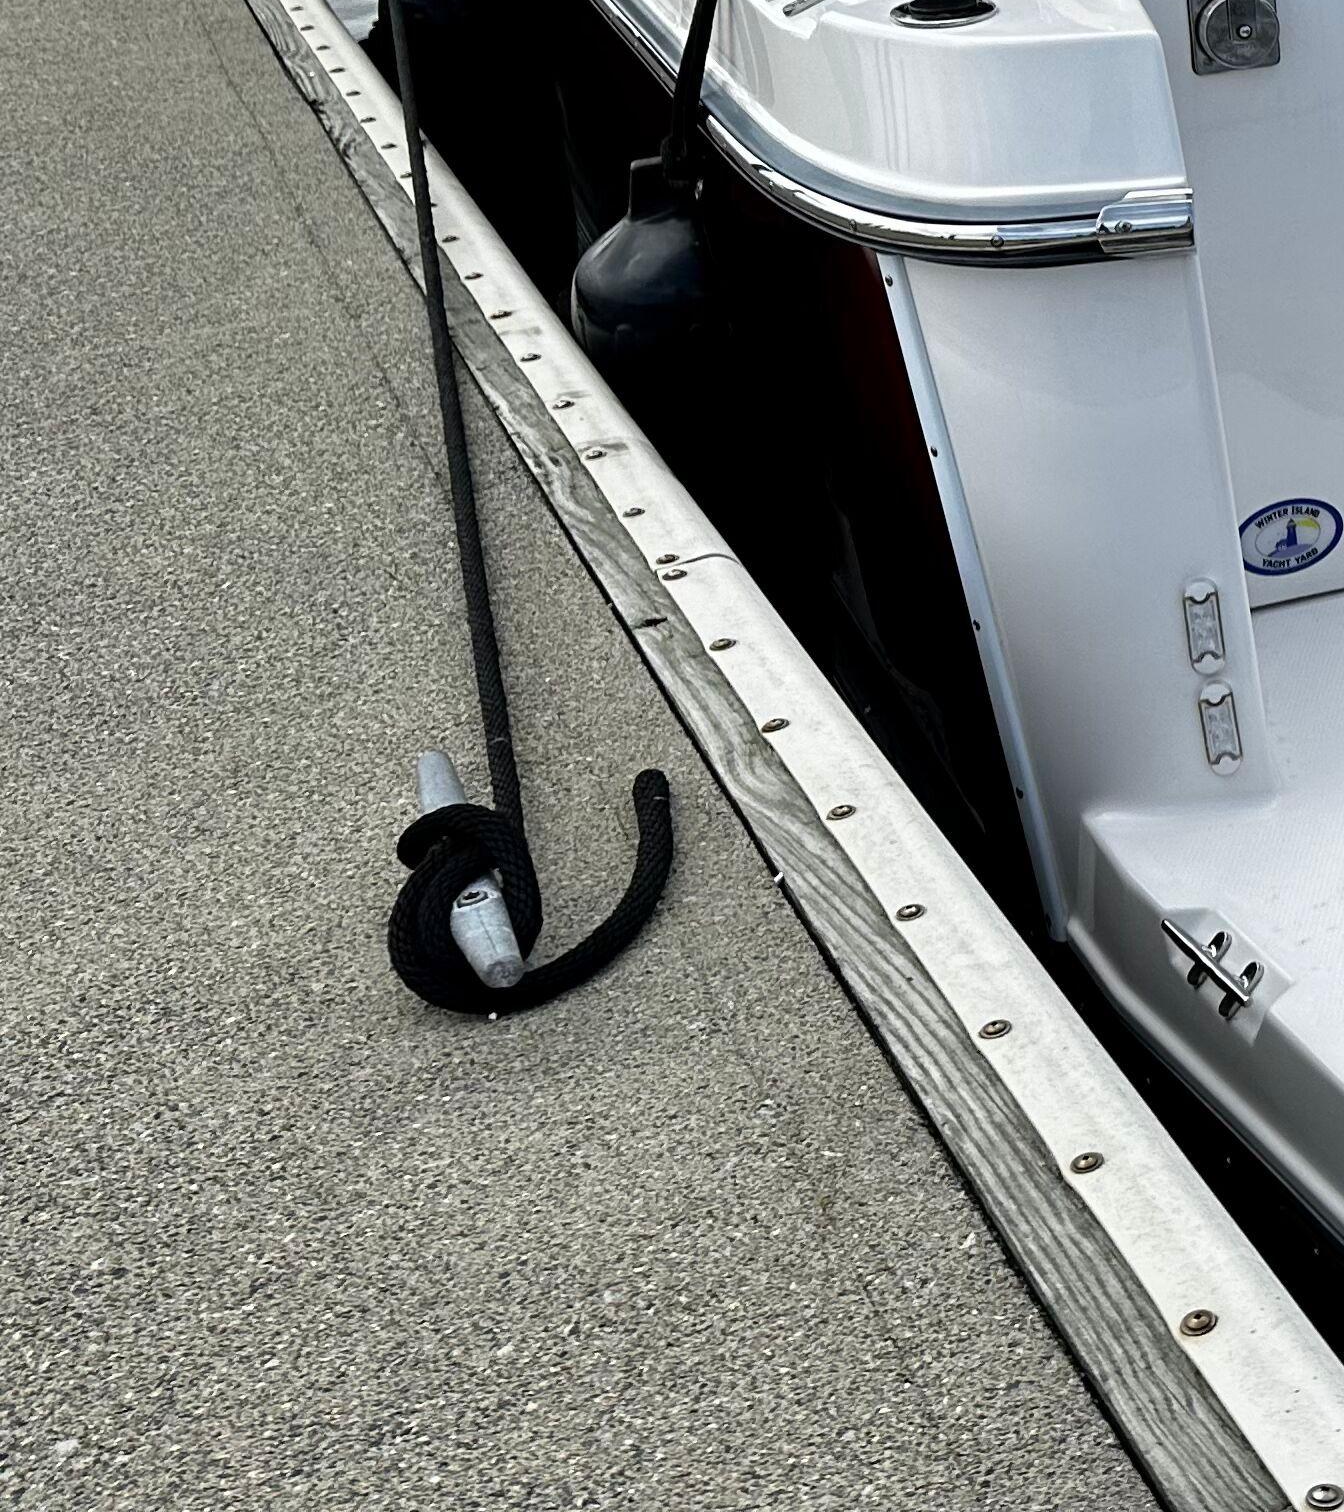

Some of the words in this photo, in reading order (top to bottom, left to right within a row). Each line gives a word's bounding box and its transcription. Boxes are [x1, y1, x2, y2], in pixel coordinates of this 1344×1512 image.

[1254, 508, 1289, 529] WINTER
[1291, 505, 1321, 518] ISLAND
[1262, 558, 1291, 568] YACHT
[1294, 547, 1319, 564] YARD
